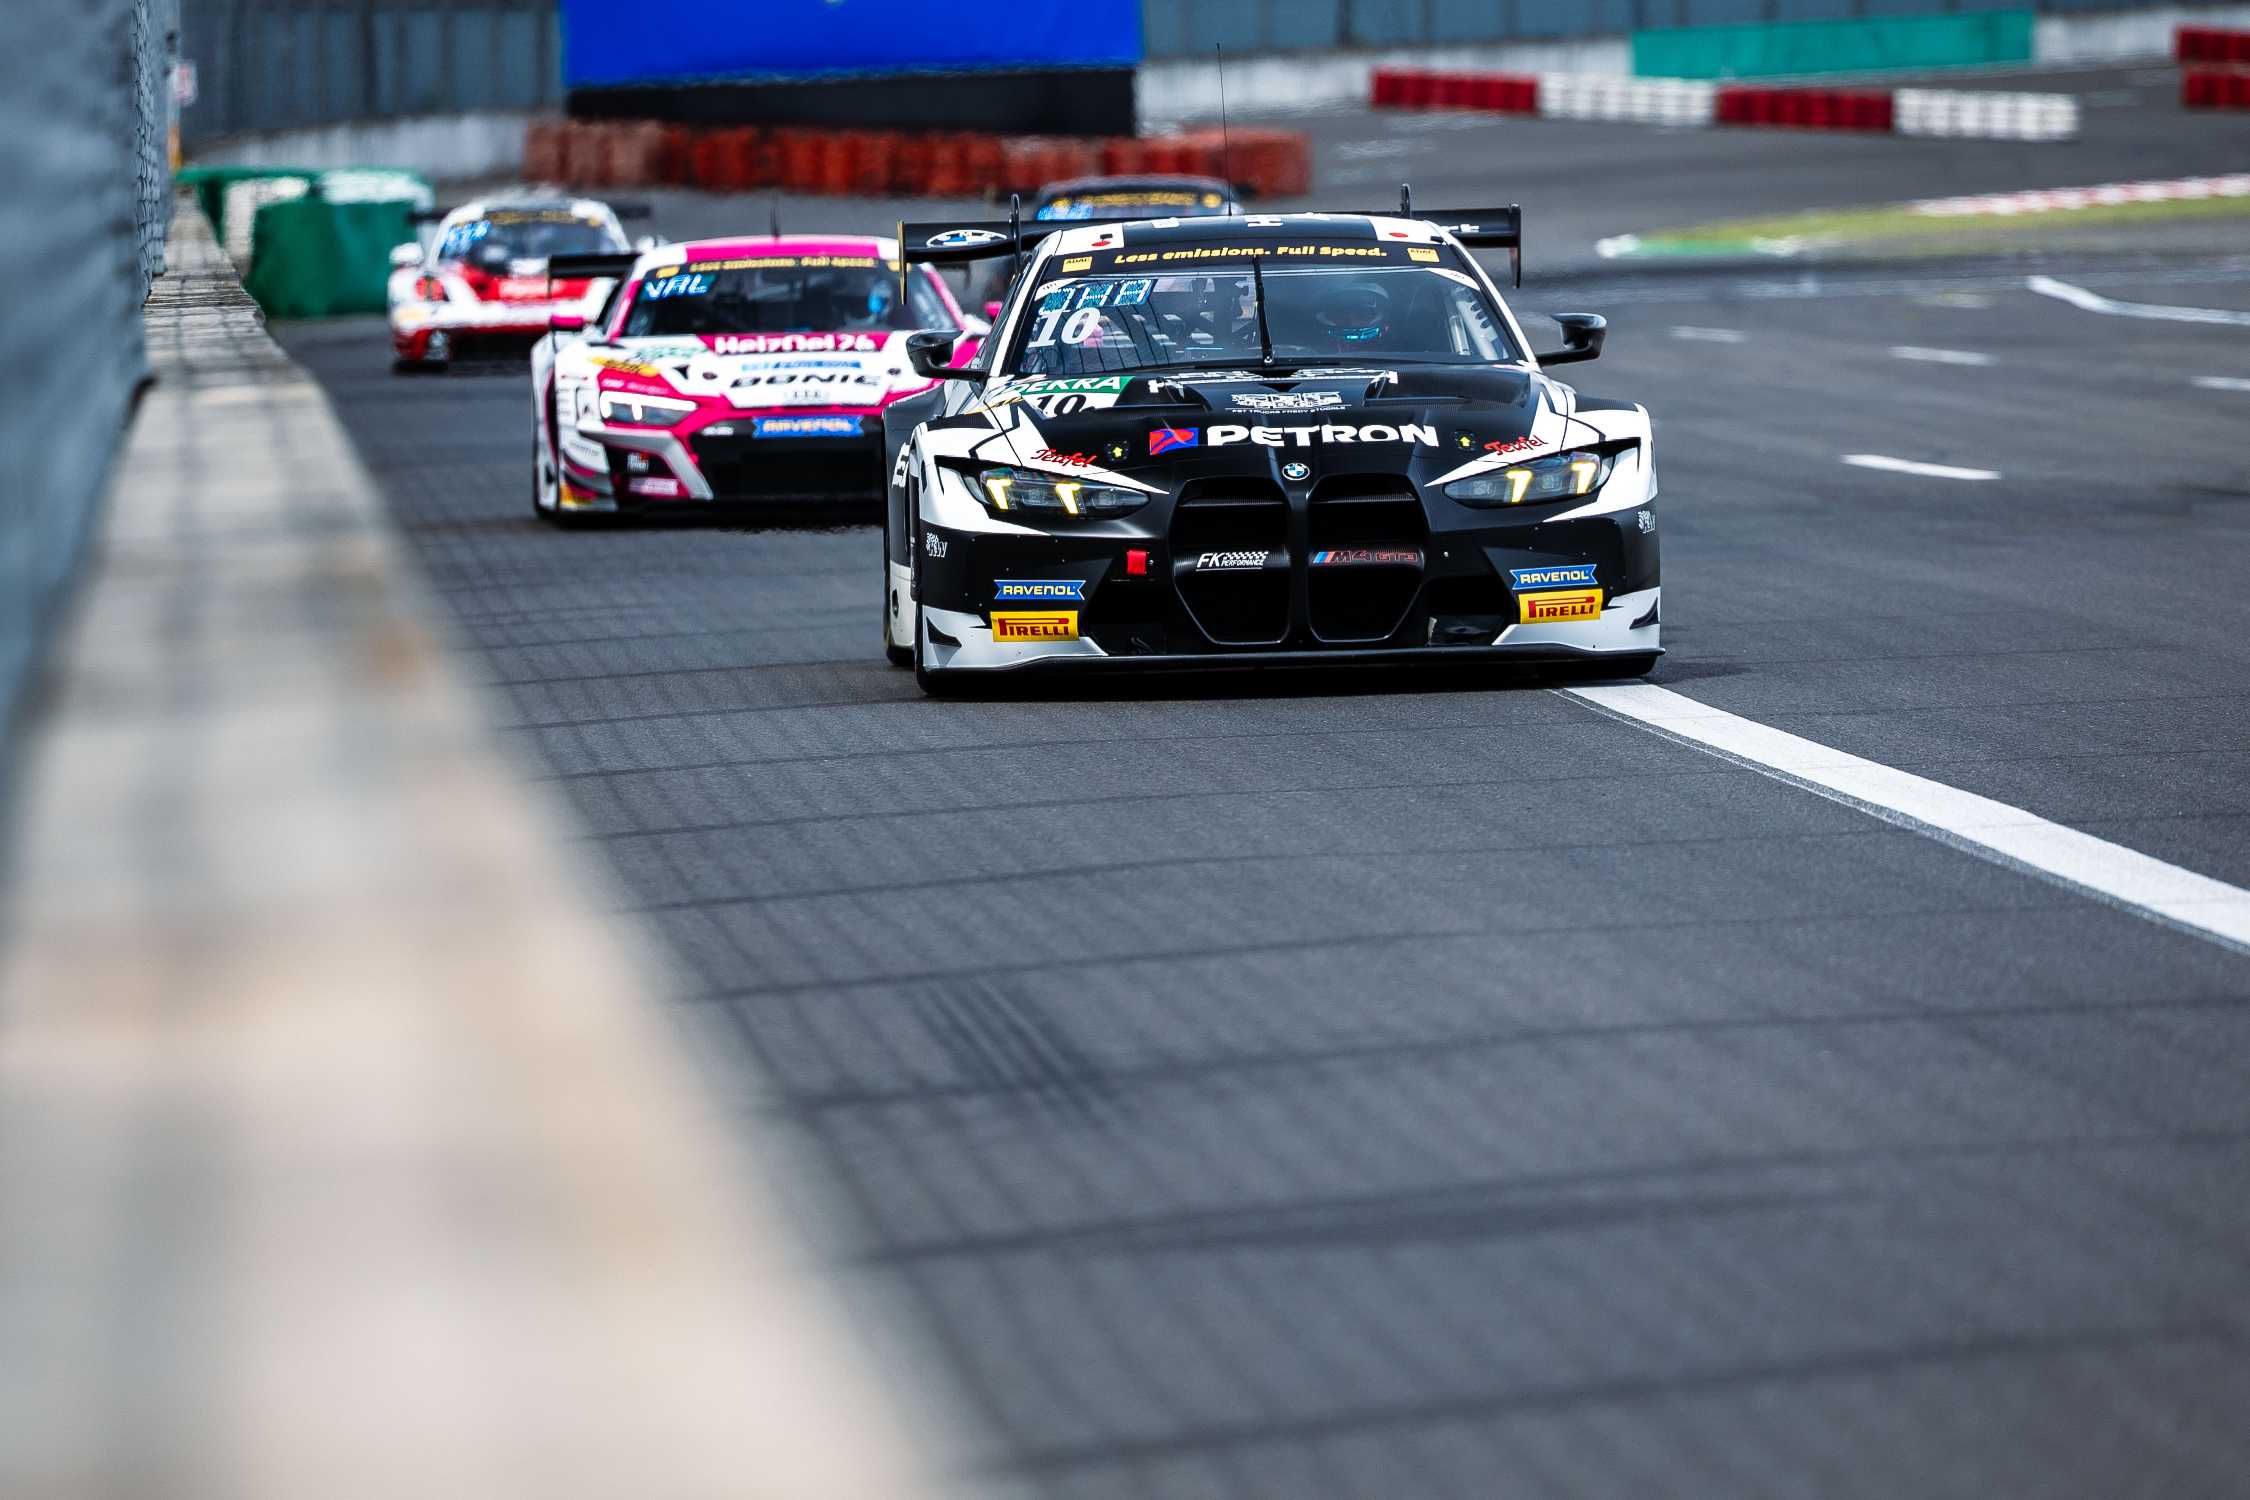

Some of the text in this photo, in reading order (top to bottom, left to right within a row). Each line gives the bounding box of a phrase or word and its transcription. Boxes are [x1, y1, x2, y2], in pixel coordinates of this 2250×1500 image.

[1114, 246, 1387, 264] Less emissions. Full Speed.
[1028, 306, 1101, 348] 10
[1008, 375, 1120, 395] DEKRA
[1206, 424, 1440, 447] PETRON
[1484, 434, 1549, 456] Teufel
[1031, 449, 1097, 468] Teufel
[1197, 552, 1264, 568] FK PERFORMANCE
[1520, 569, 1590, 584] RAVENOL
[1003, 585, 1077, 595] RAVENOL
[1528, 596, 1596, 618] PIRELLI
[997, 617, 1070, 637] PIRELLI
